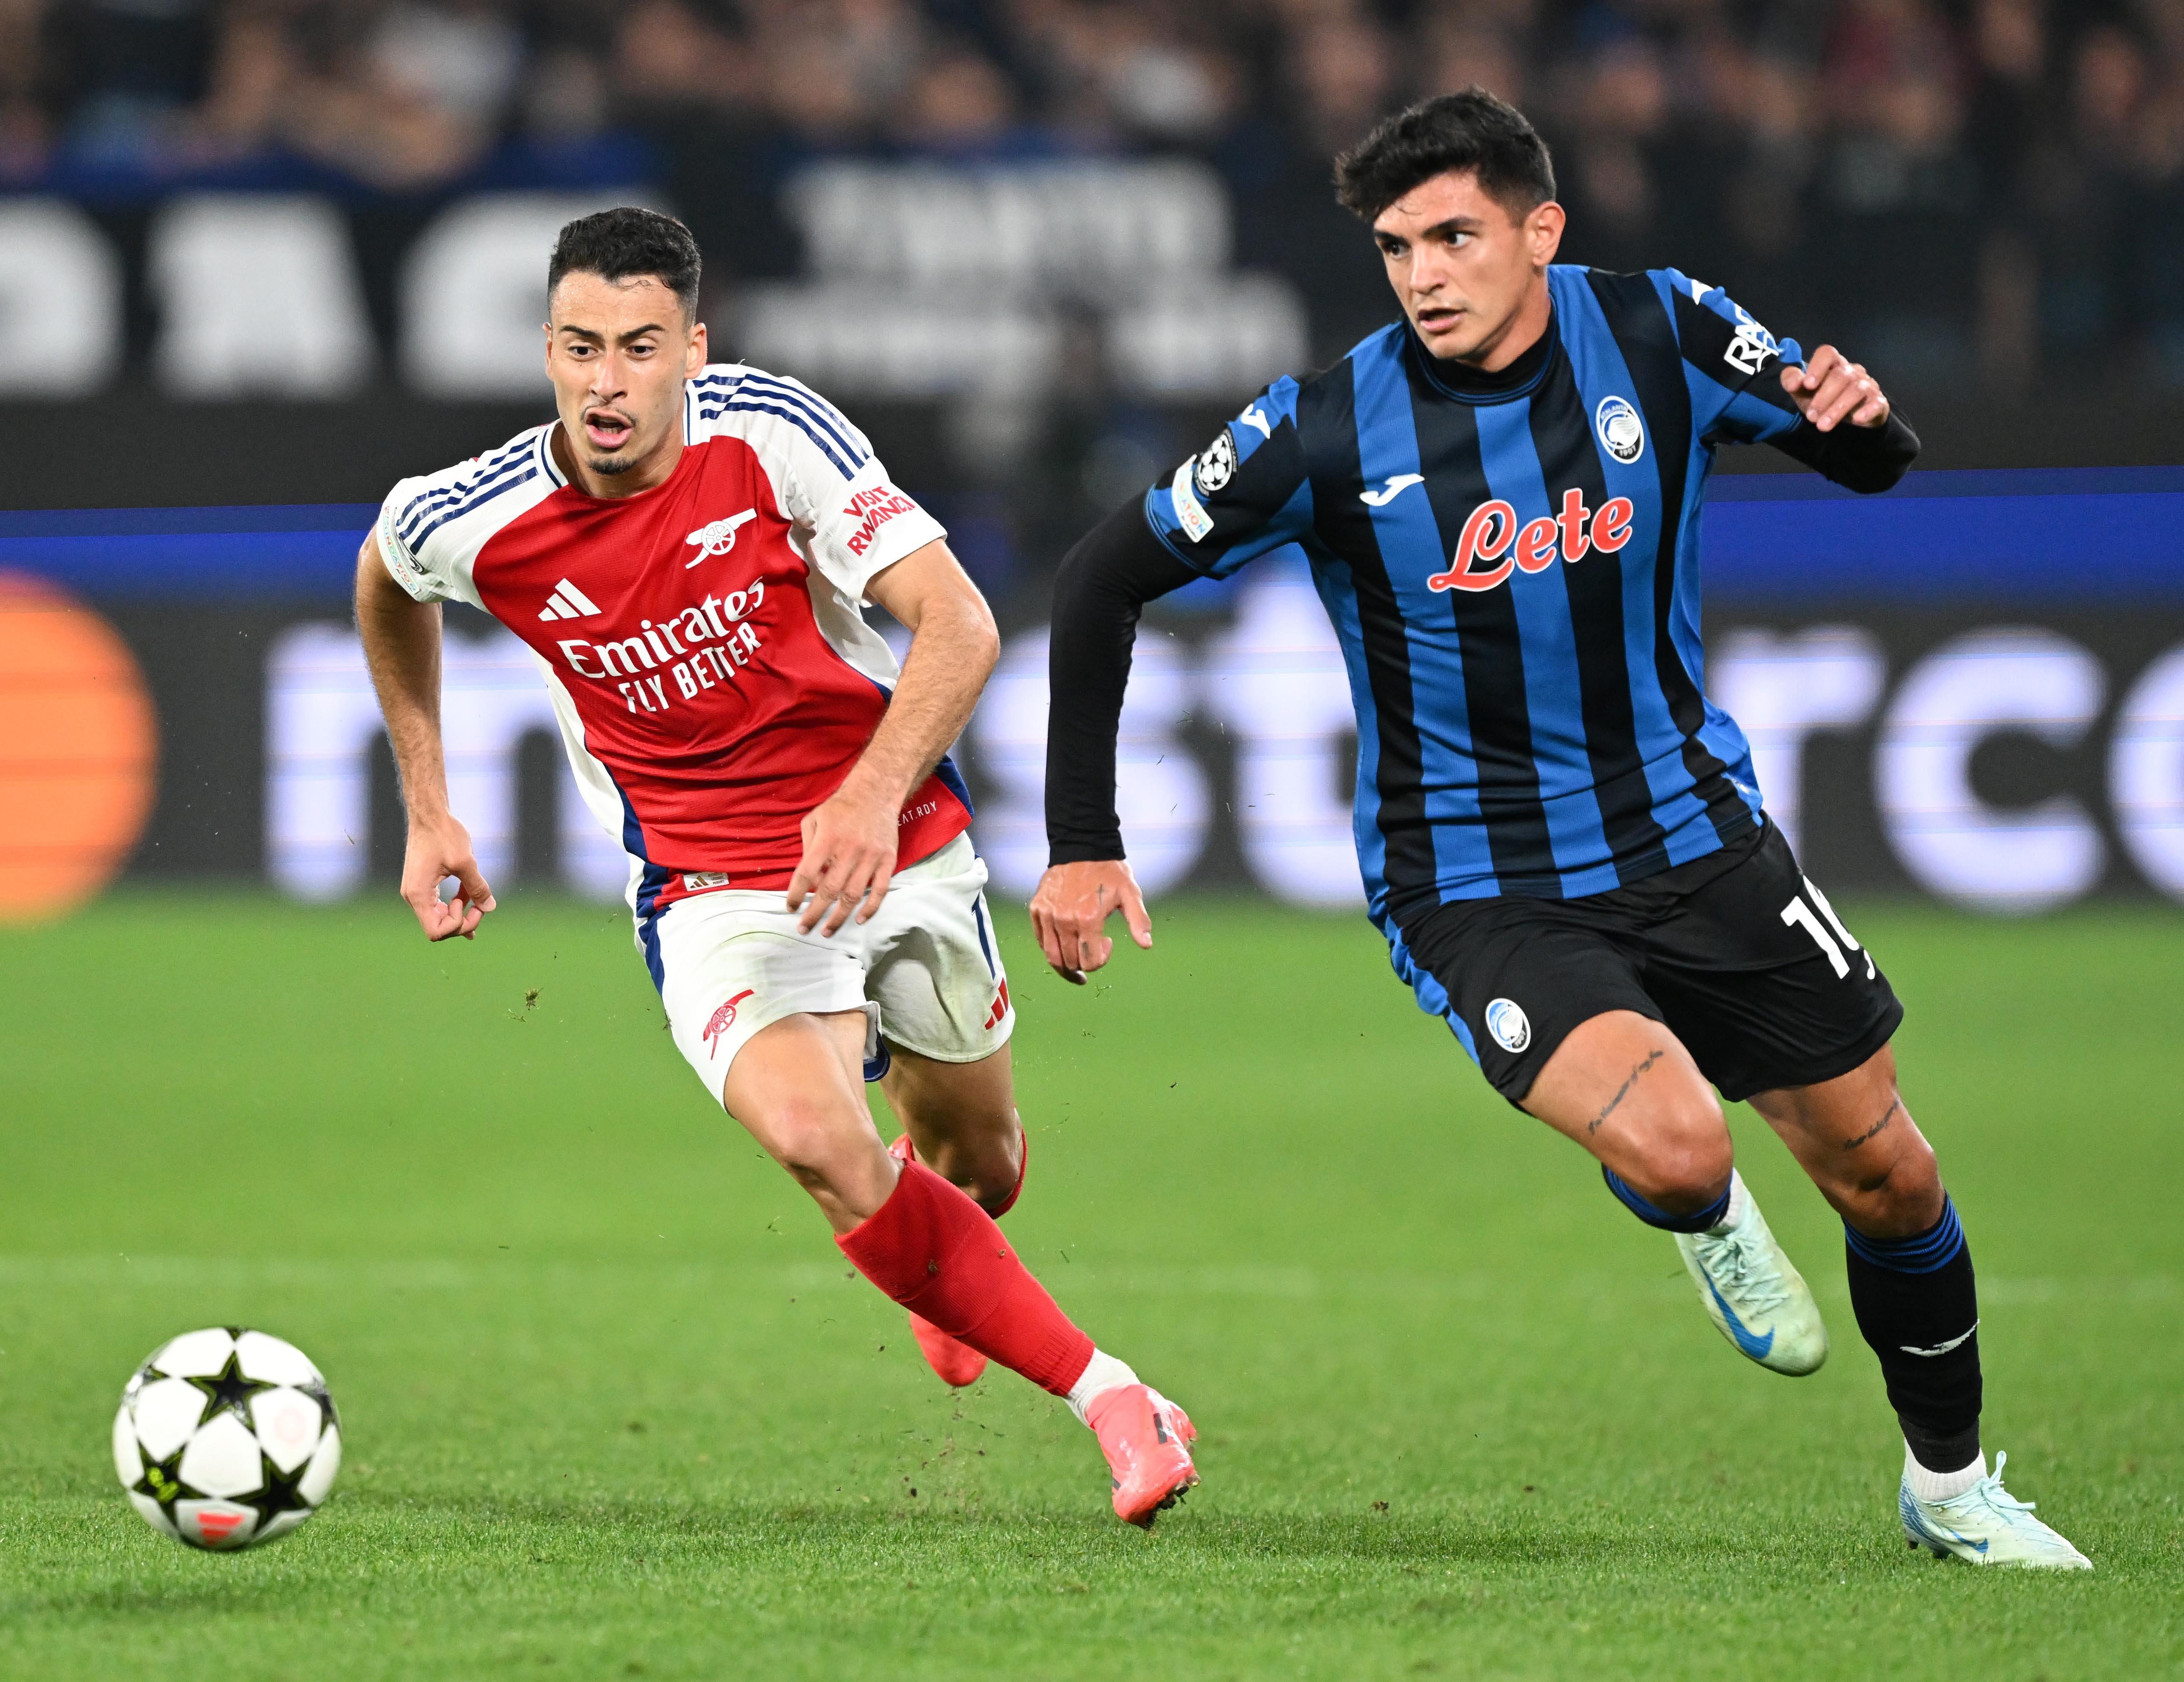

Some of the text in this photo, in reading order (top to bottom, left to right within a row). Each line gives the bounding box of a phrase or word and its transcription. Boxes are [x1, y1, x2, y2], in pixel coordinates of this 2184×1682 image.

[843, 486, 890, 517] VISIT
[1427, 487, 1634, 593] Lete
[556, 576, 764, 678] Emirates
[618, 622, 762, 714] FLY BETTER
[897, 800, 937, 827] EAT.RDY
